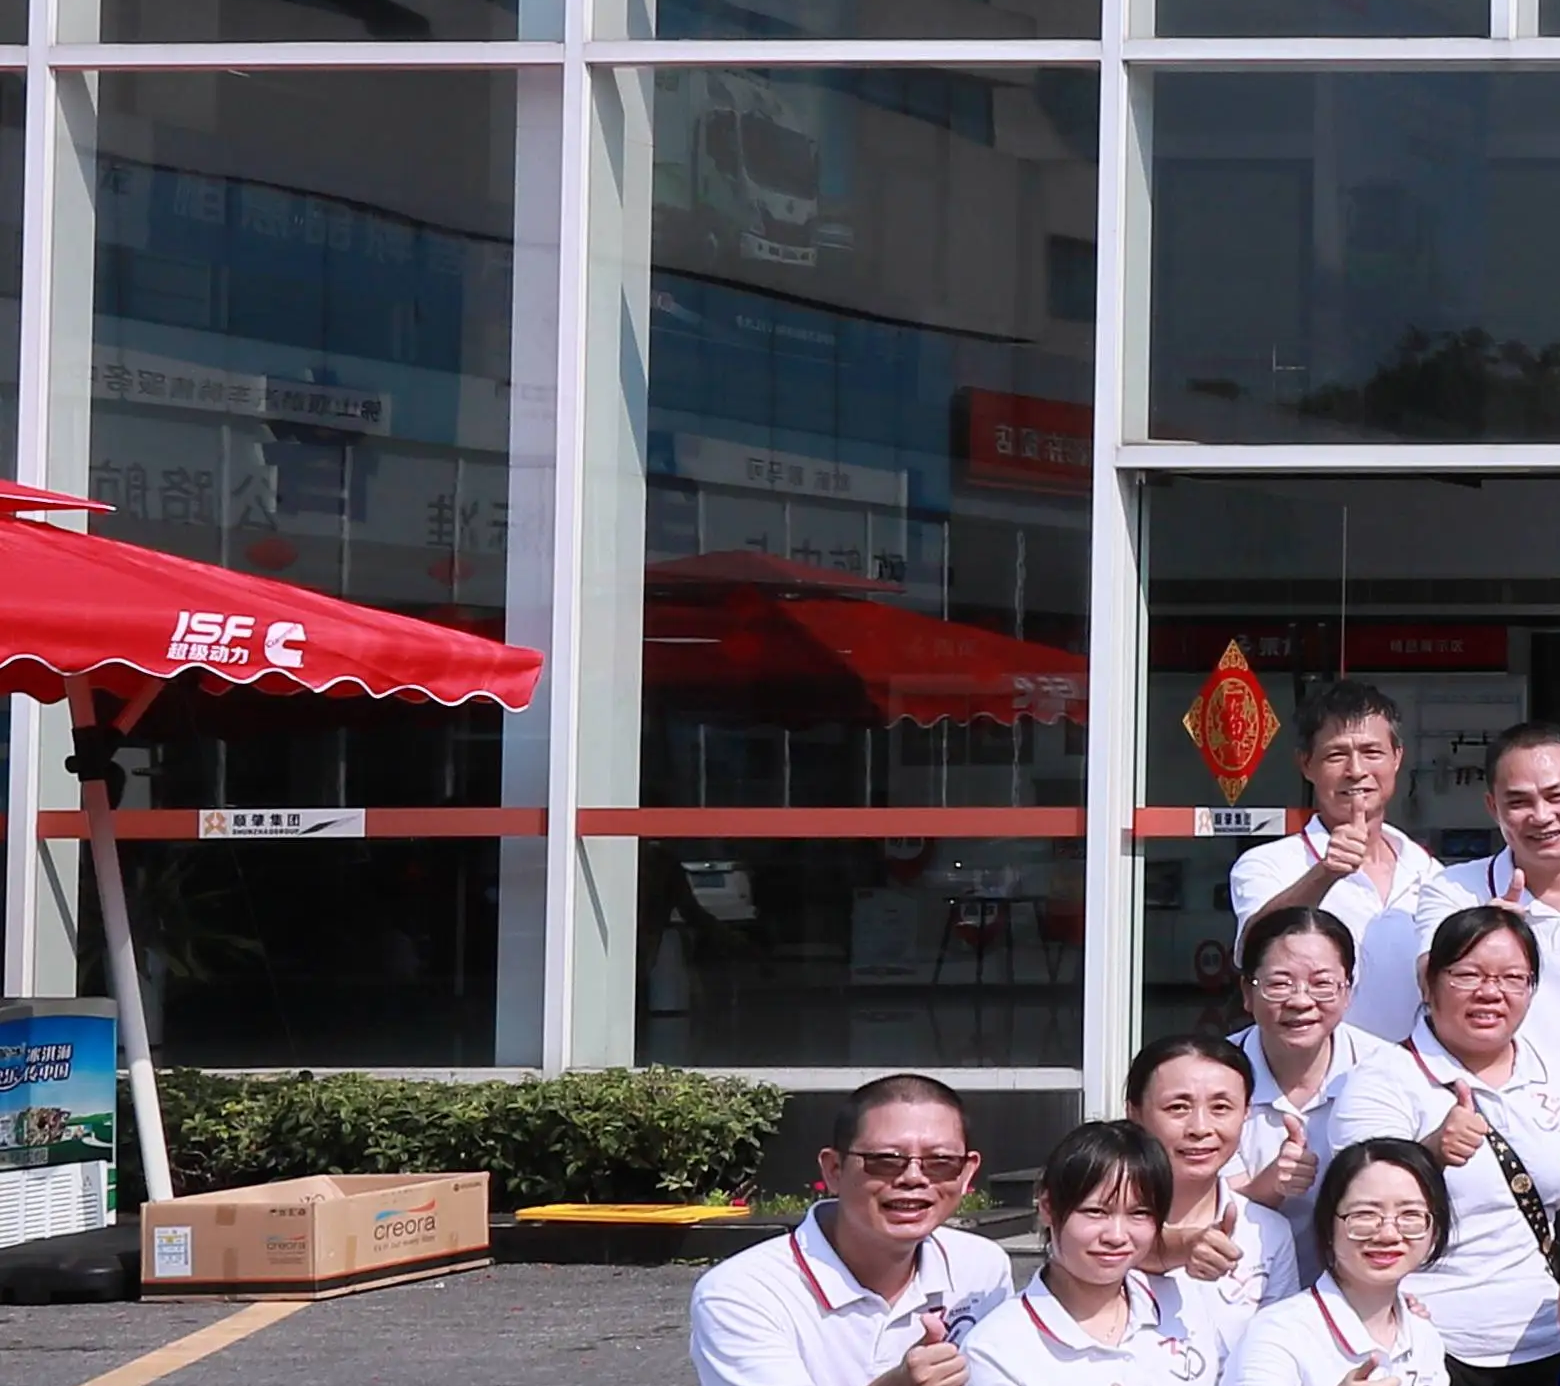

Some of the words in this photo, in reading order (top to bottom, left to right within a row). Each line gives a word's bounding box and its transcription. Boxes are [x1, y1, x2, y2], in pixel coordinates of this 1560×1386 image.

[171, 611, 255, 645] ISF
[166, 643, 250, 666] 超级动力
[233, 813, 301, 827] 顺肇集团
[373, 1214, 437, 1241] creora
